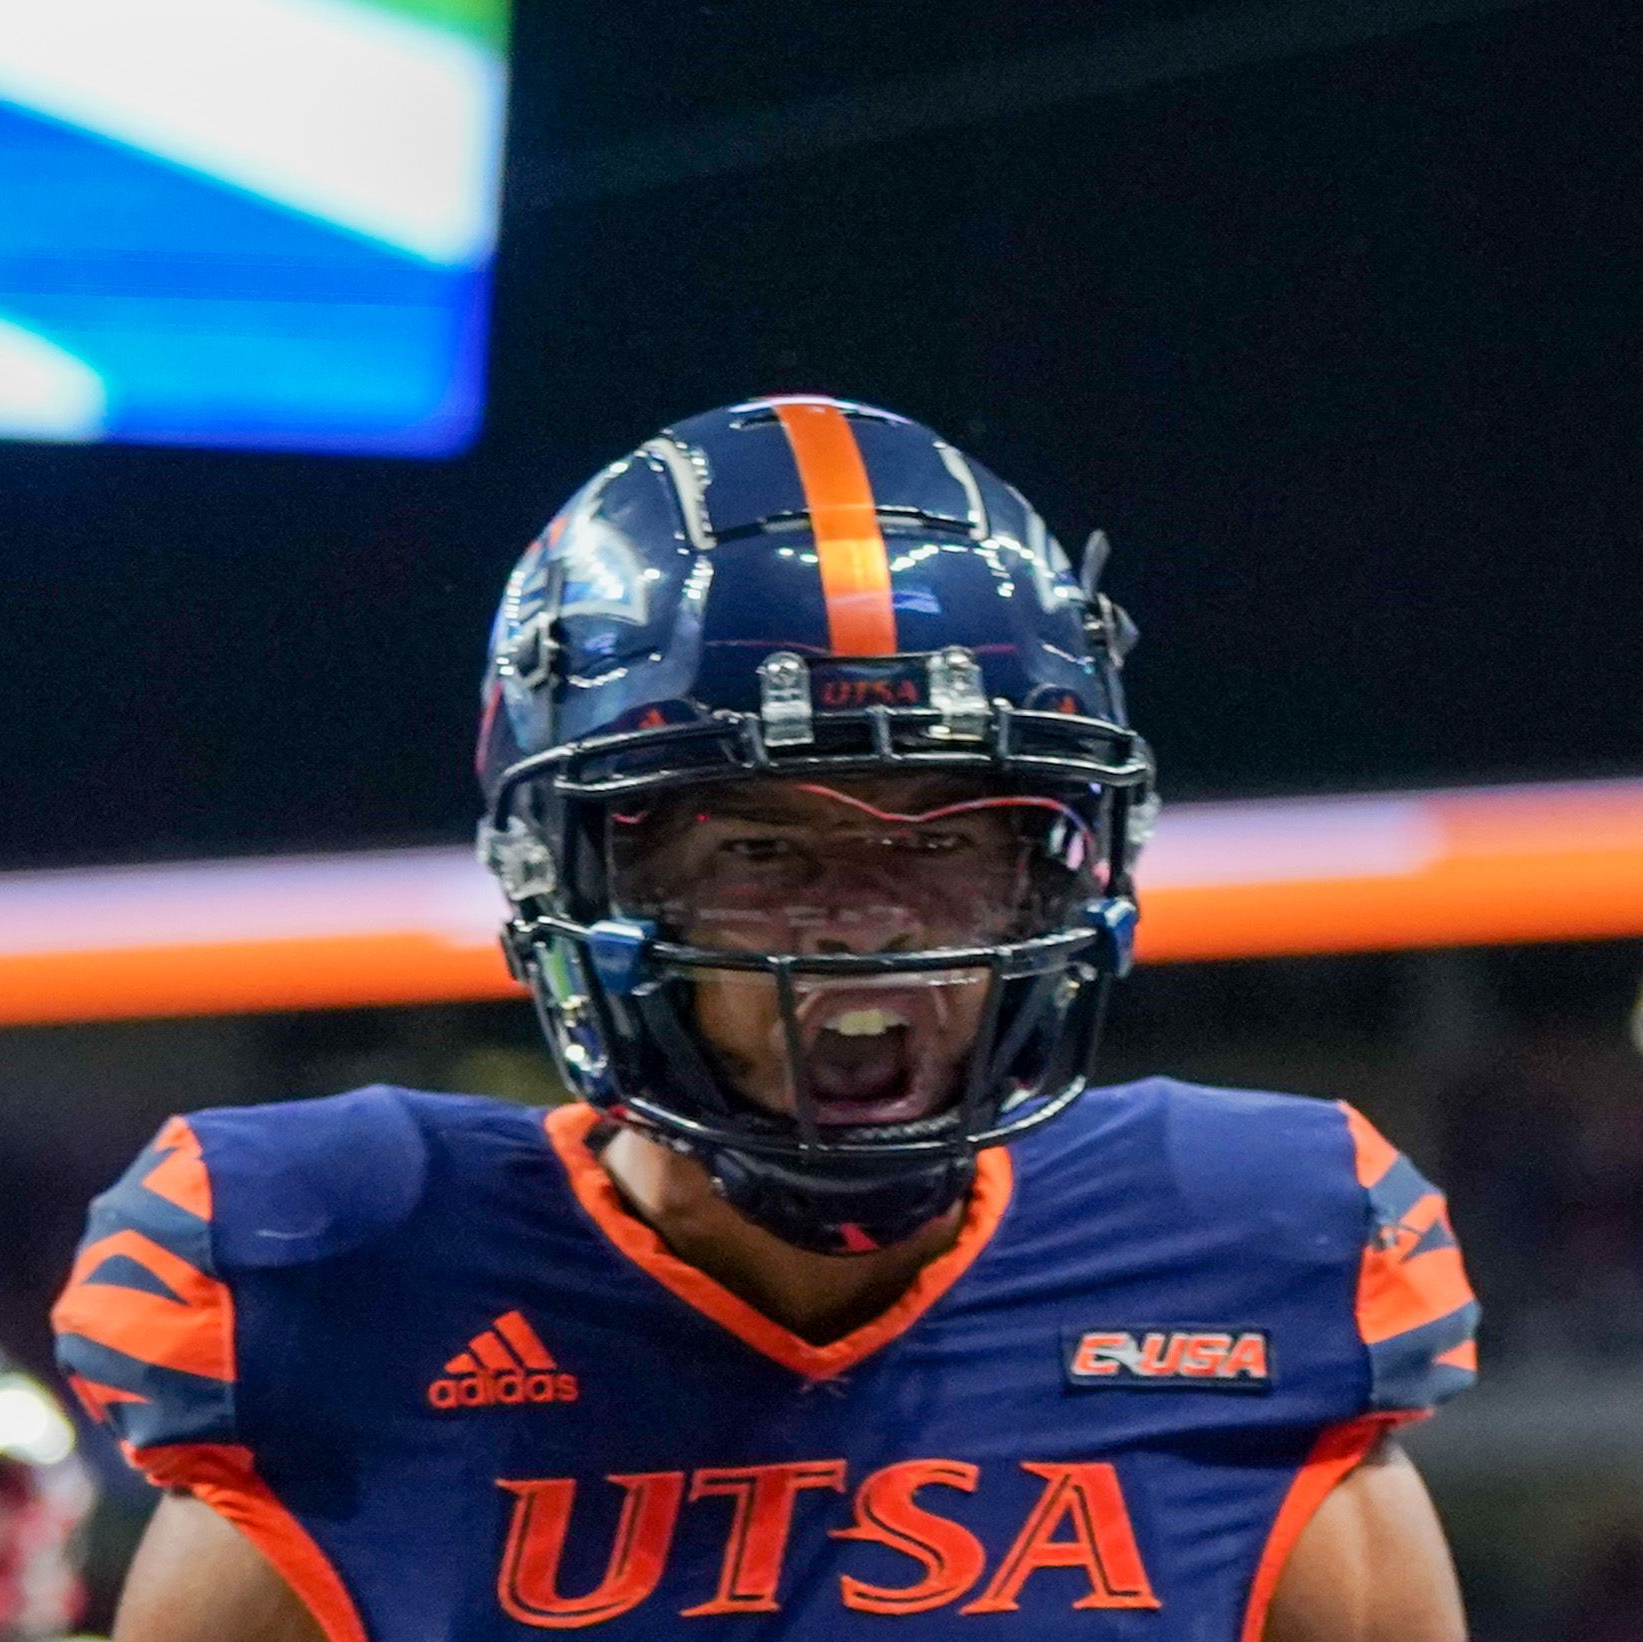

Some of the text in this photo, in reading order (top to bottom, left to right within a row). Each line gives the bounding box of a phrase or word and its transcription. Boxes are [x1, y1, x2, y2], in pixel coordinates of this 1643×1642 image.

[821, 679, 919, 706] UTSA
[428, 1372, 579, 1409] adidas
[494, 1458, 1163, 1629] UTSA
